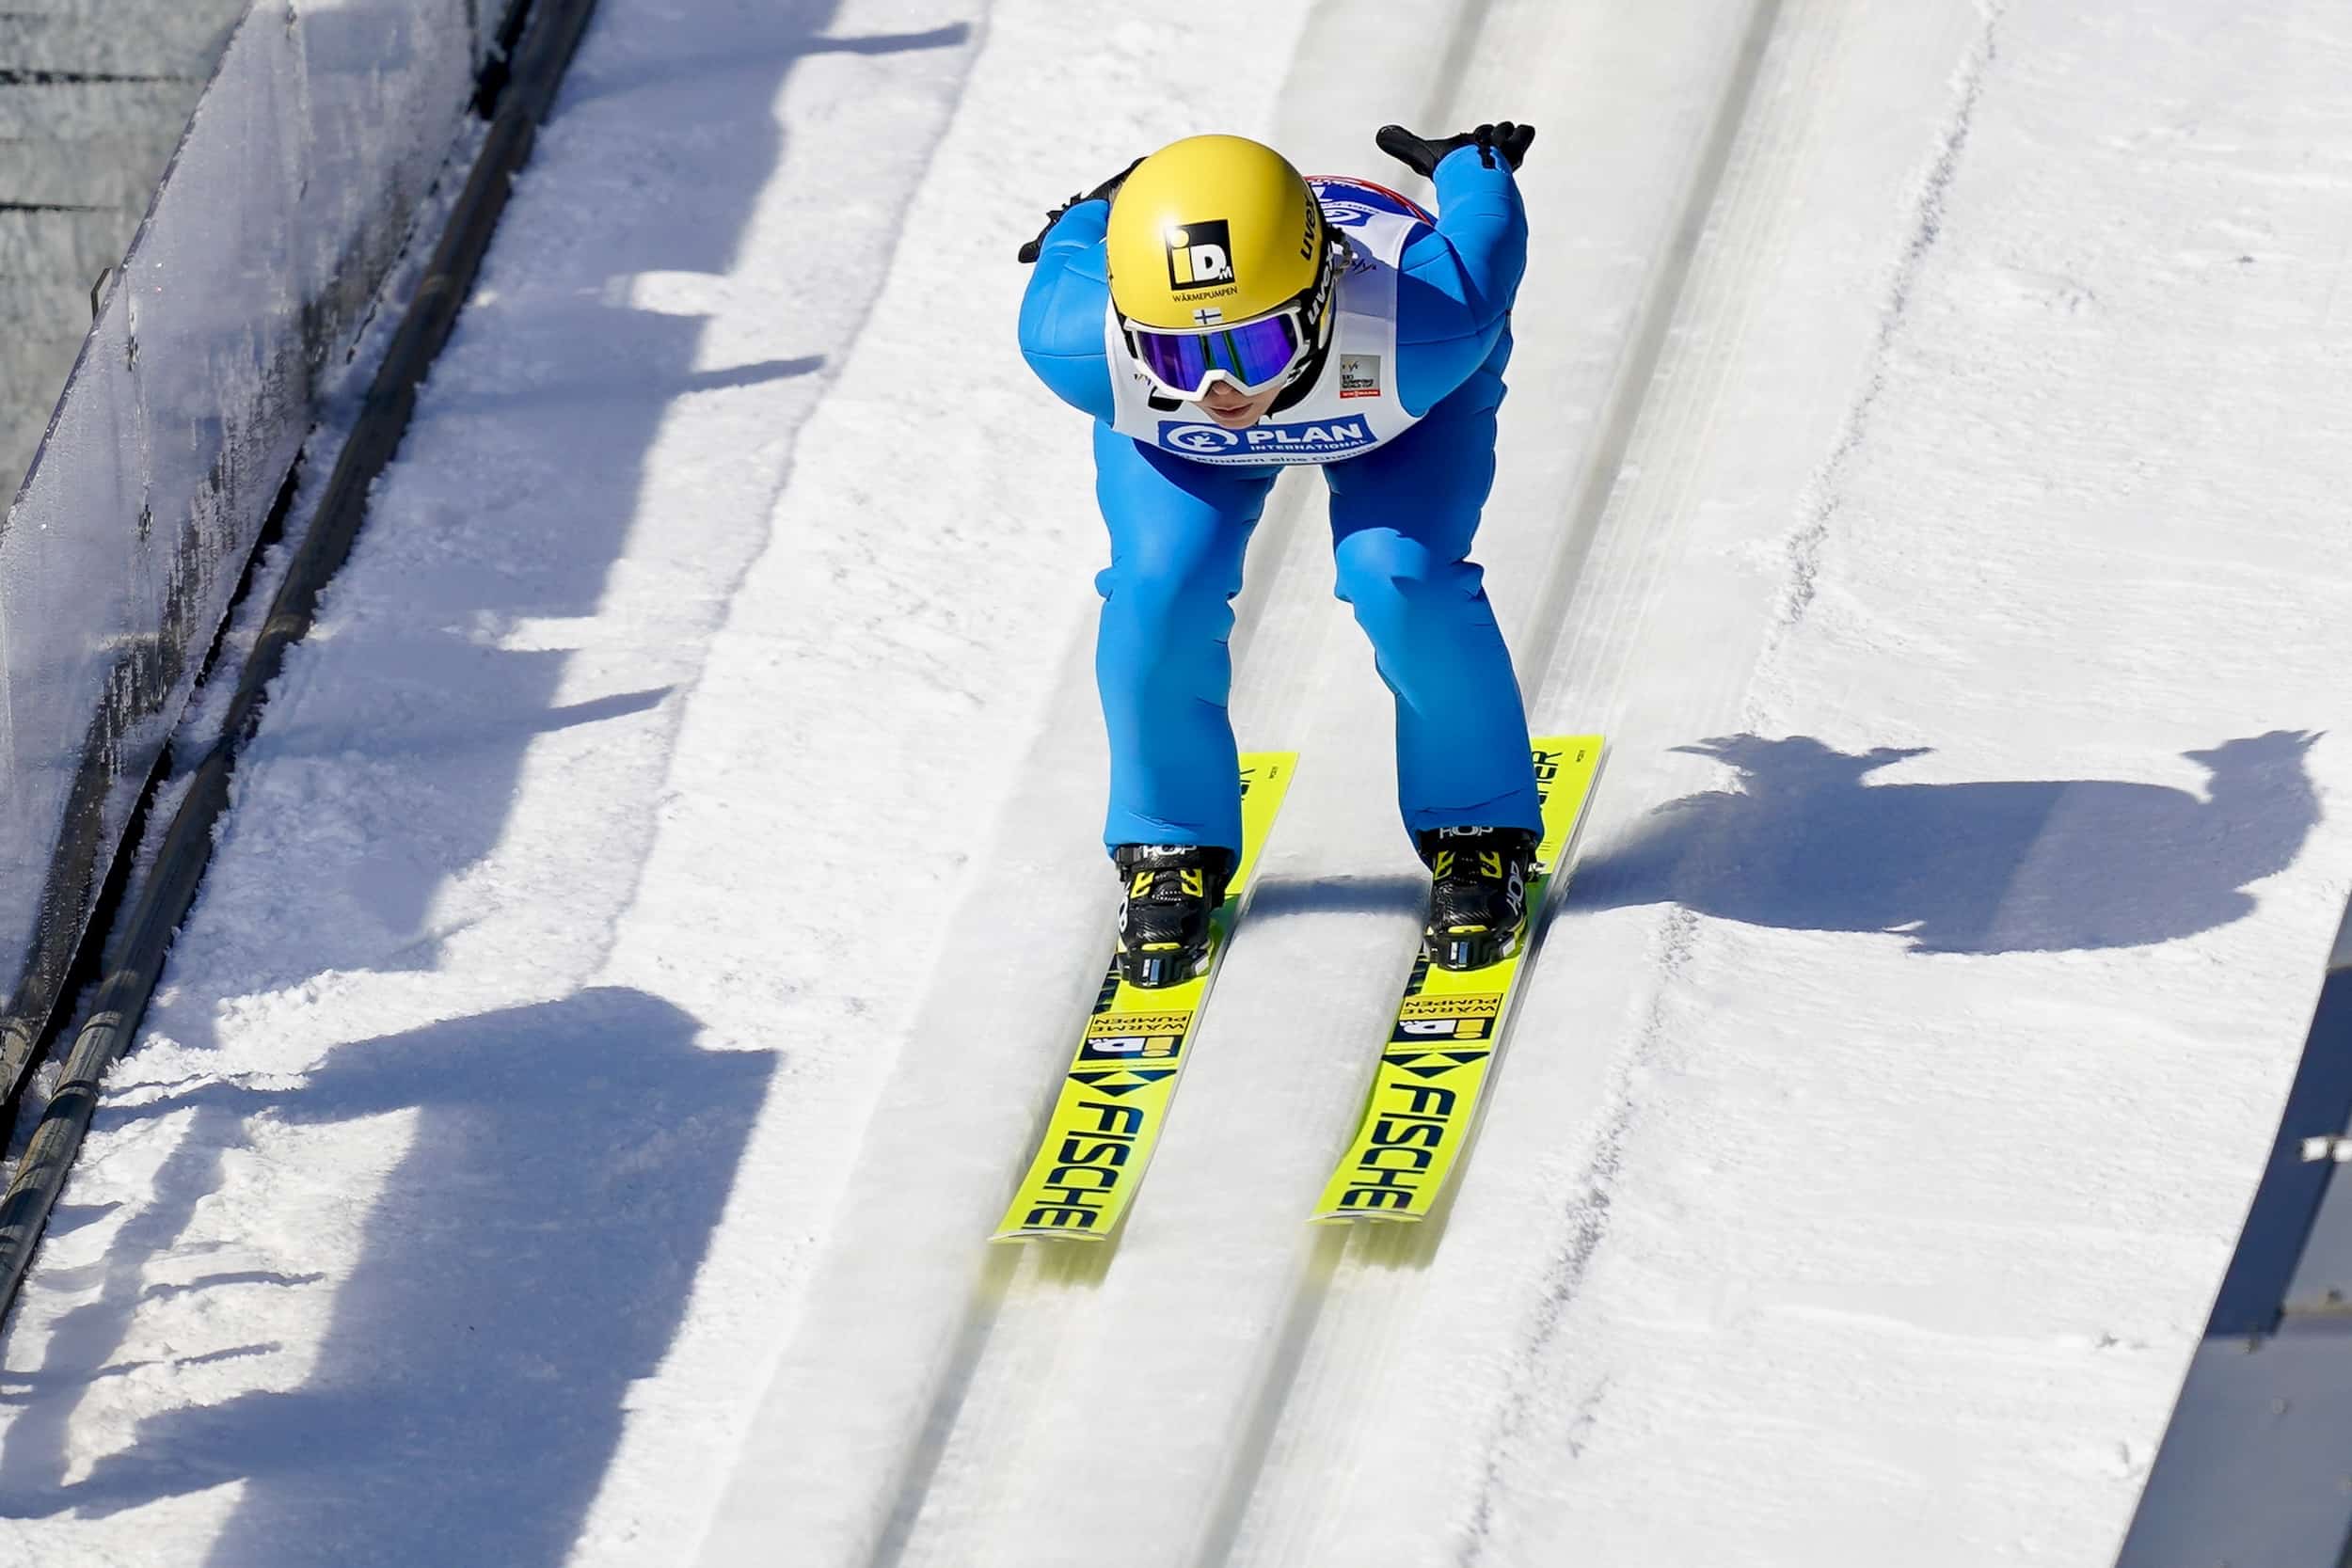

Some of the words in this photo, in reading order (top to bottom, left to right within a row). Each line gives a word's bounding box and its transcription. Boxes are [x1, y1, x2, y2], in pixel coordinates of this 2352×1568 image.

[1300, 194, 1316, 261] uvex
[1307, 245, 1334, 325] uvex
[1247, 422, 1363, 445] PLAN
[1249, 439, 1368, 451] INTERNATIONAL
[1021, 1101, 1145, 1231] FISCHE
[1337, 1083, 1456, 1211] FISCHE
